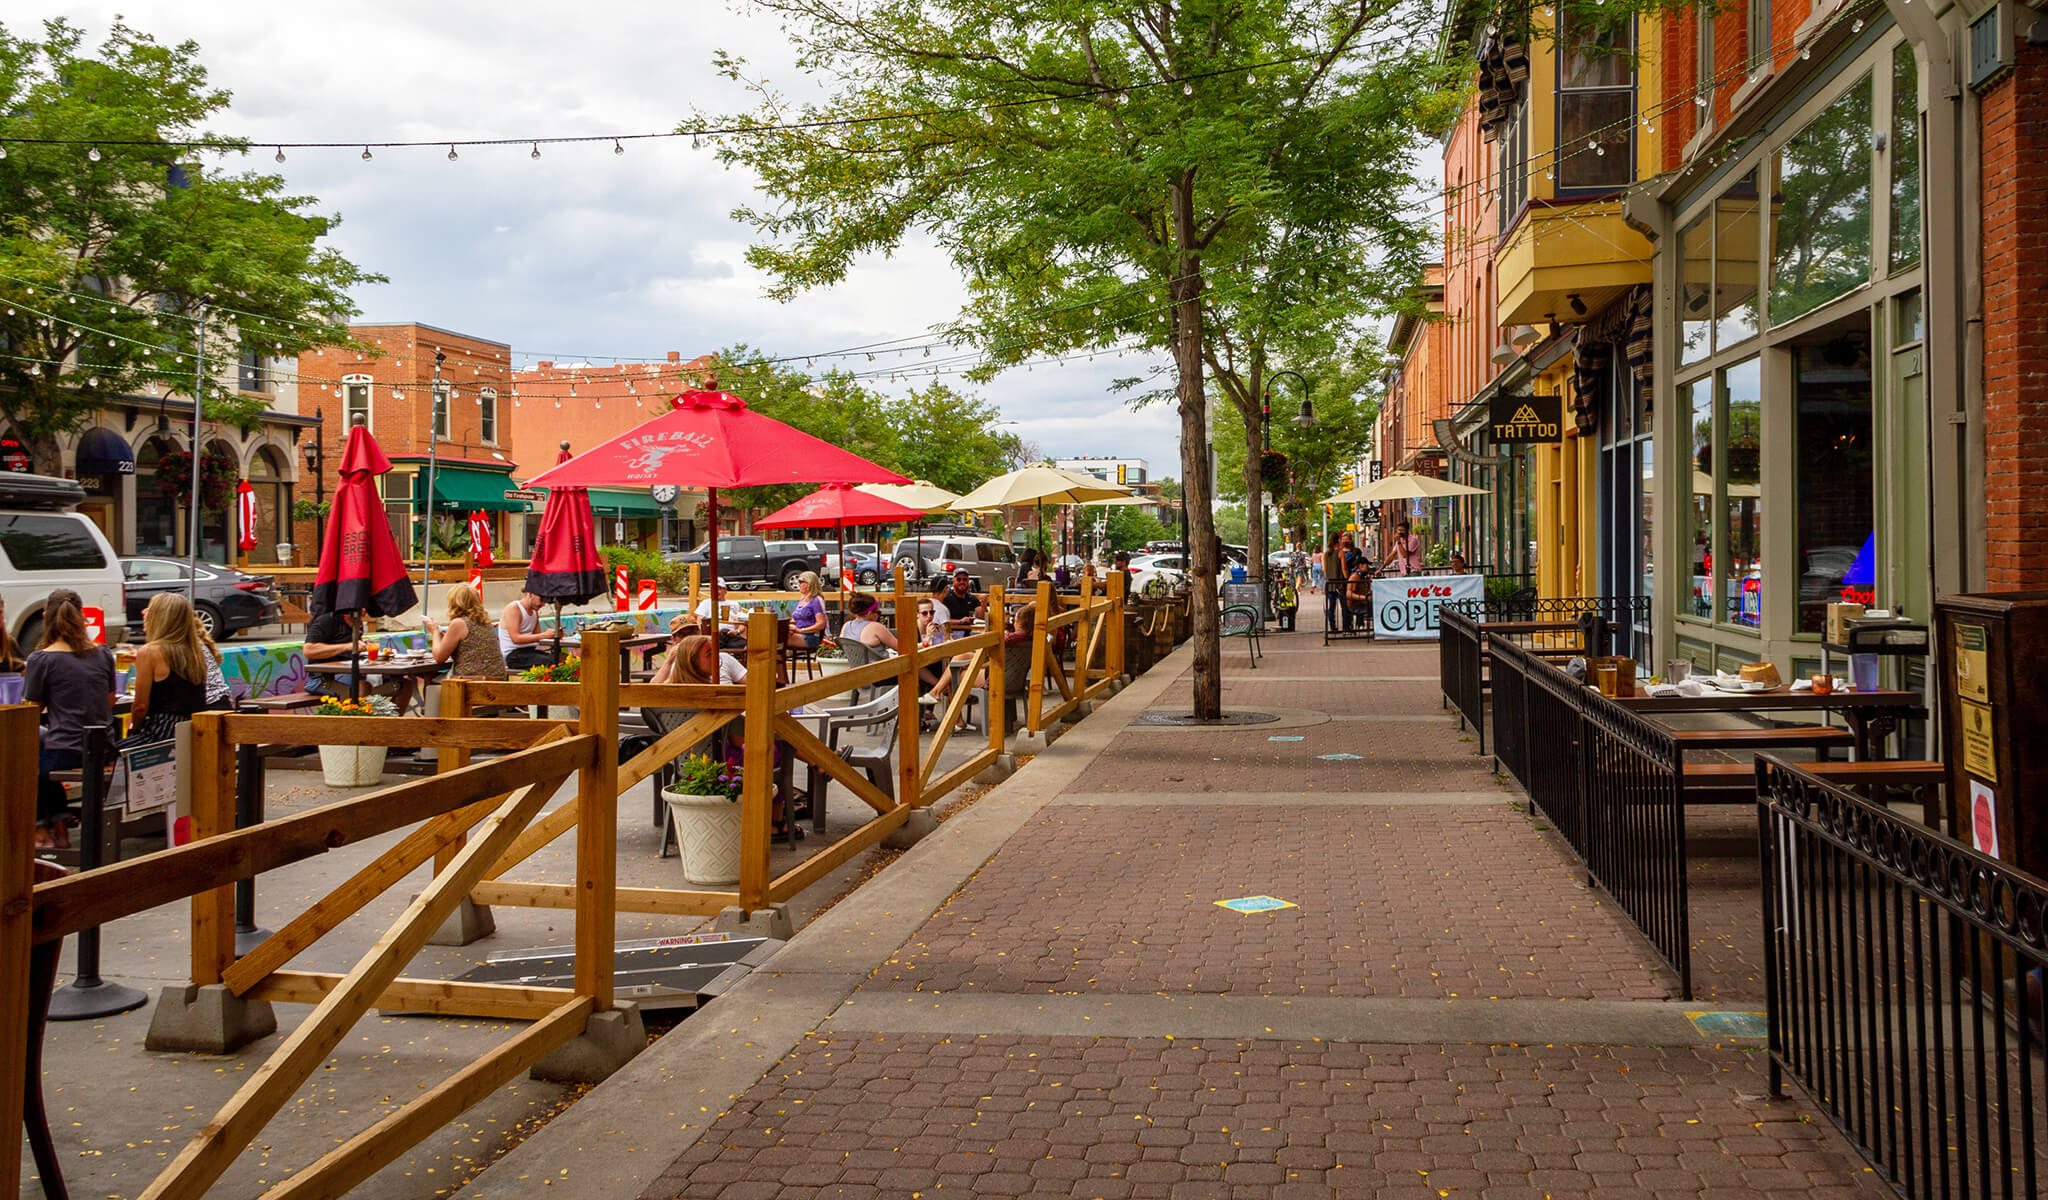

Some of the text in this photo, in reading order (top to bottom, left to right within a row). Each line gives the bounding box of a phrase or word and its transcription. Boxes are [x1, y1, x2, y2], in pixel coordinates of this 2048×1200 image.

[1494, 424, 1557, 438] TATTOO
[1, 439, 20, 448] OPEN
[620, 432, 714, 449] FIREBALL
[118, 461, 134, 472] 223
[1407, 584, 1452, 598] we're
[659, 936, 693, 946] WARNING
